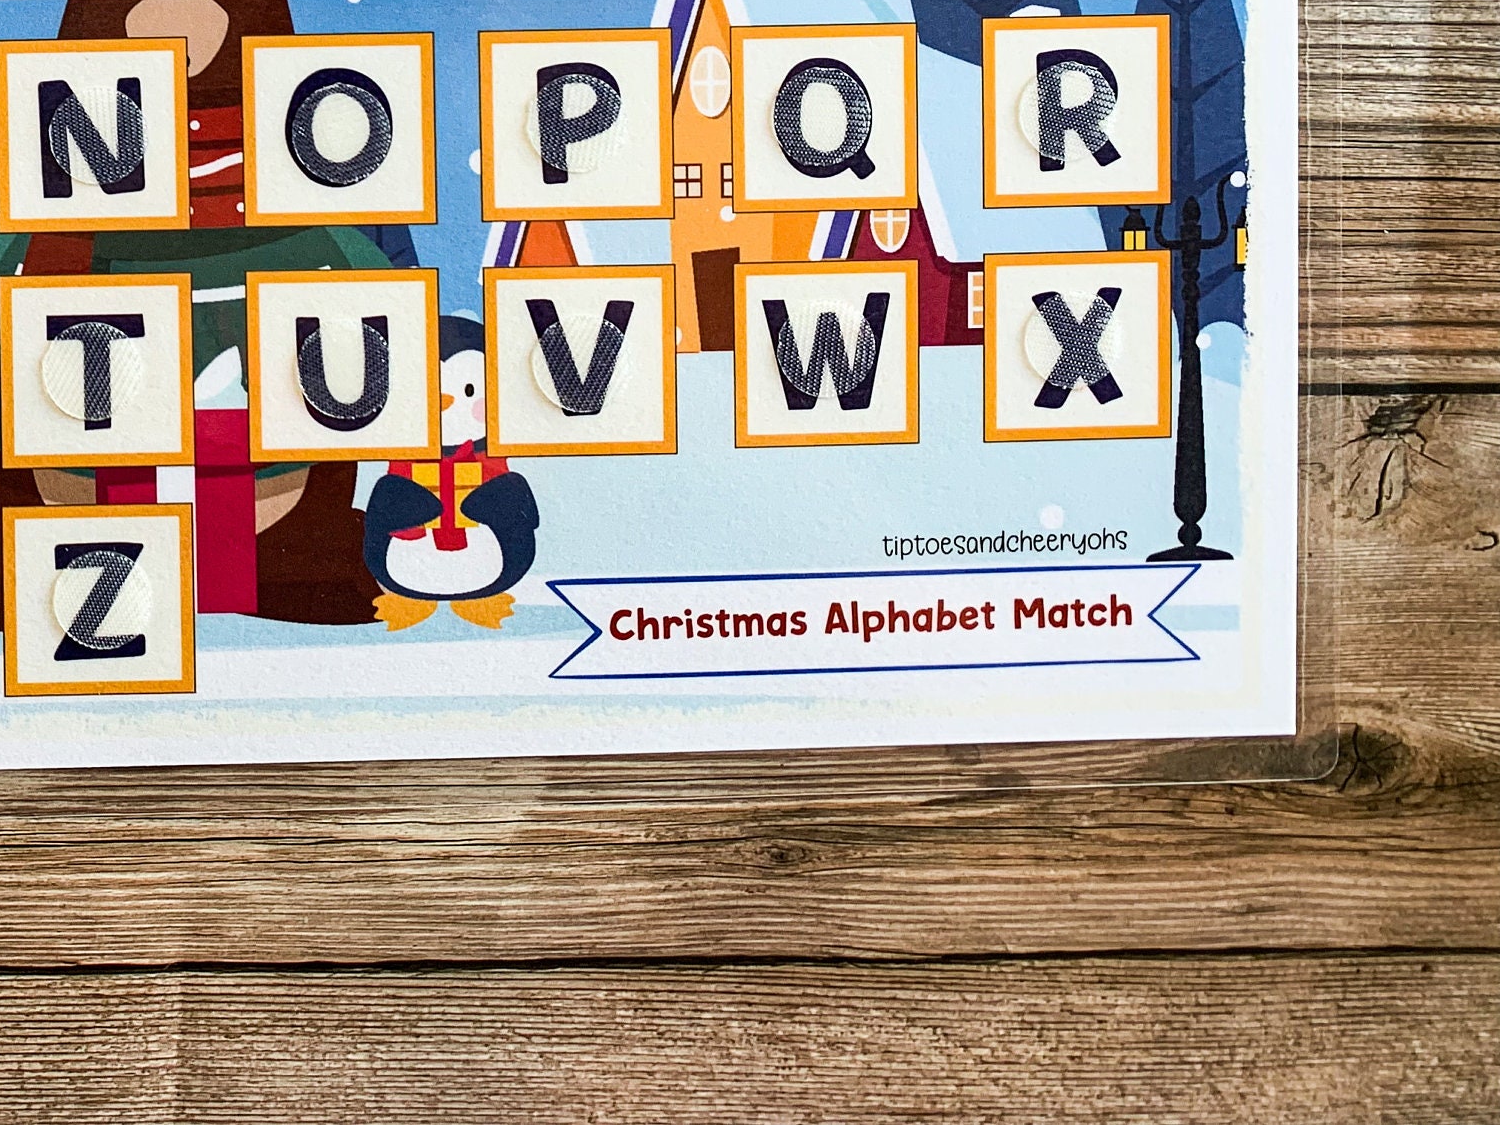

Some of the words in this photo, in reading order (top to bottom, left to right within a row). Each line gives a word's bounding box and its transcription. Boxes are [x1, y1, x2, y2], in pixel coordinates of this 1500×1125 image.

[38, 77, 145, 198] N
[285, 68, 393, 187] O
[537, 63, 621, 184] P
[774, 58, 875, 179] Q
[1037, 49, 1121, 172] R
[47, 314, 145, 430] T
[296, 316, 389, 431] U
[525, 299, 634, 416] V
[762, 293, 890, 410] W
[1032, 287, 1123, 409] X
[54, 542, 146, 661] Z
[882, 527, 1128, 560] tiptoesandcheeryohs
[609, 607, 808, 641] Christmas
[824, 599, 996, 642] Alphabet
[1013, 594, 1134, 630] Match
